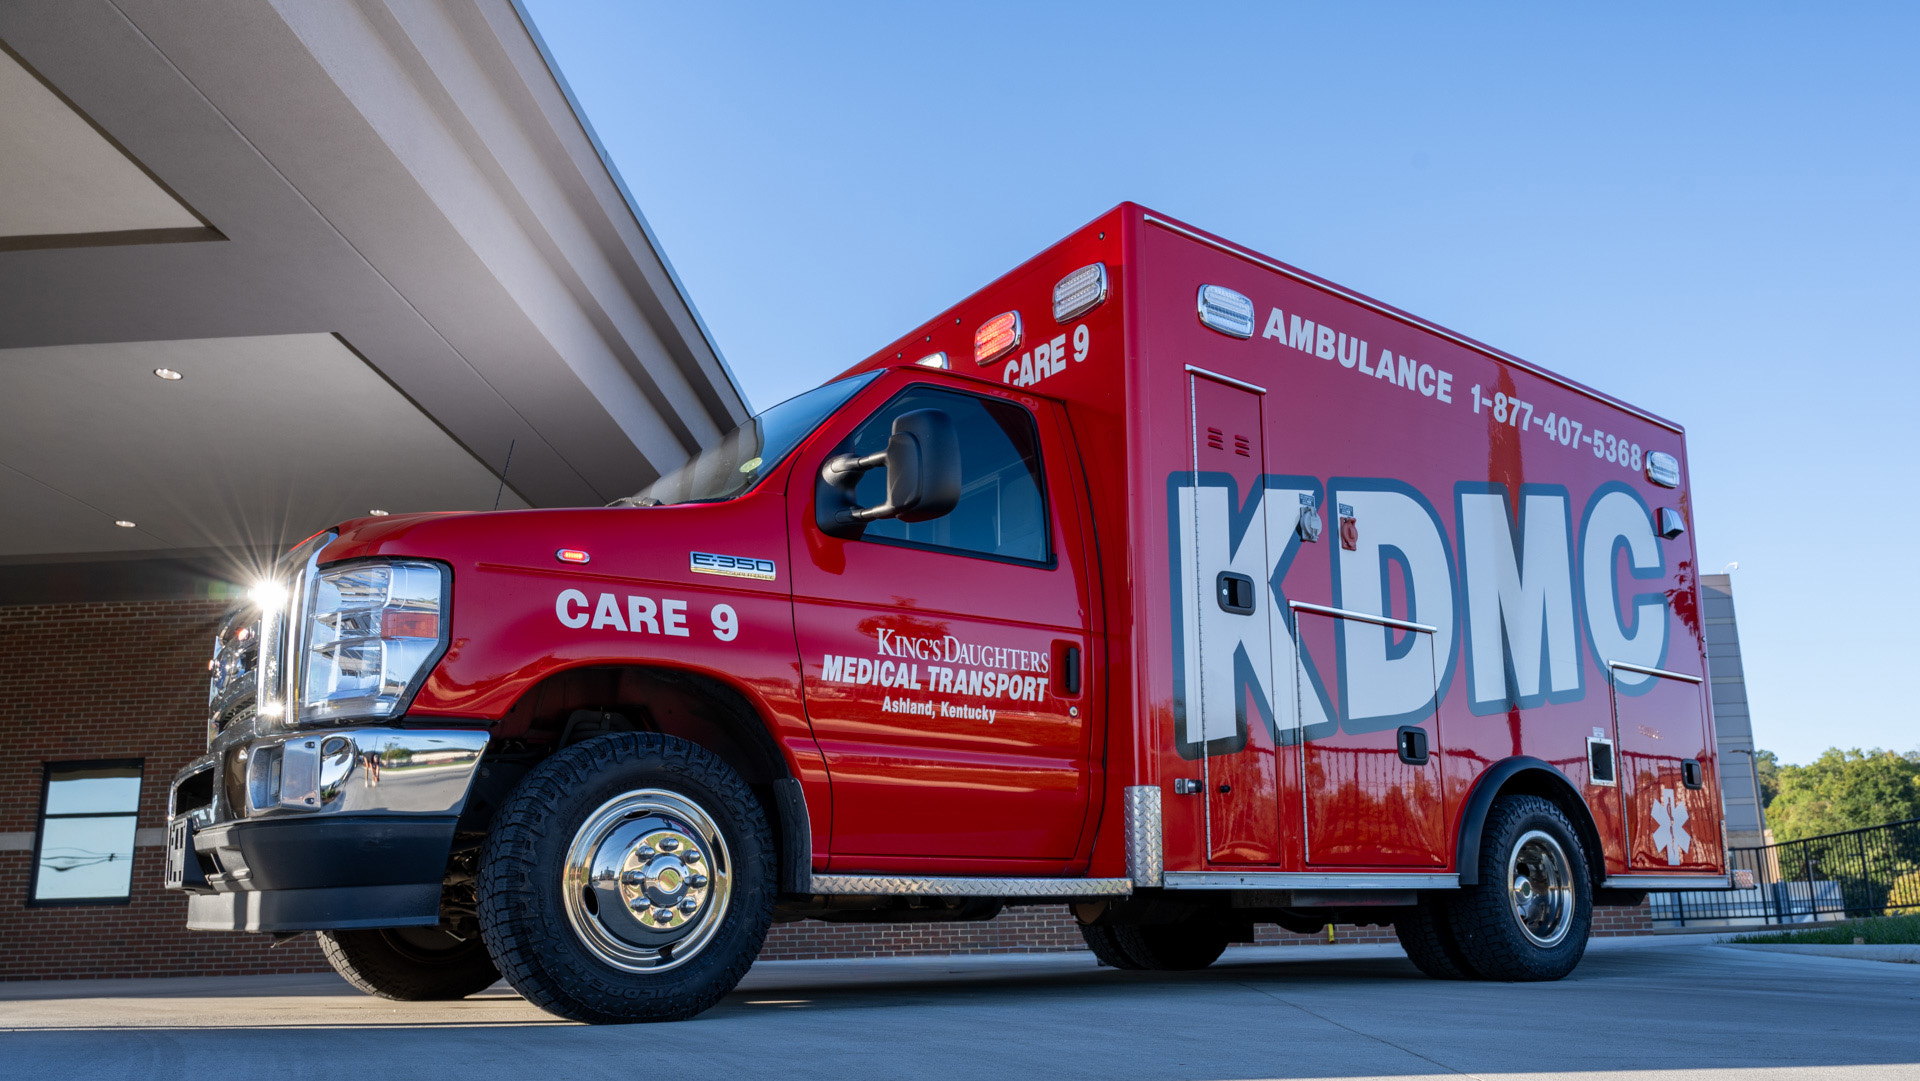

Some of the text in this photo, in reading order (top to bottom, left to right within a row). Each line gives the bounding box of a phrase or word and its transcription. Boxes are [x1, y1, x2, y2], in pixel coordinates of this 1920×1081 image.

[1003, 323, 1090, 388] CARE 9
[1262, 307, 1642, 472] AMBULANCE 1-877-407-5368
[693, 553, 774, 573] E-350
[555, 588, 739, 642] CARE 9
[1168, 471, 1669, 760] KDMC
[876, 627, 1049, 673] KING'S DAUGHTERS
[821, 654, 1049, 702] MEDICAL TRANSPORT
[882, 696, 996, 724] Ashland, Kentucky
[662, 762, 748, 832] FALKEN
